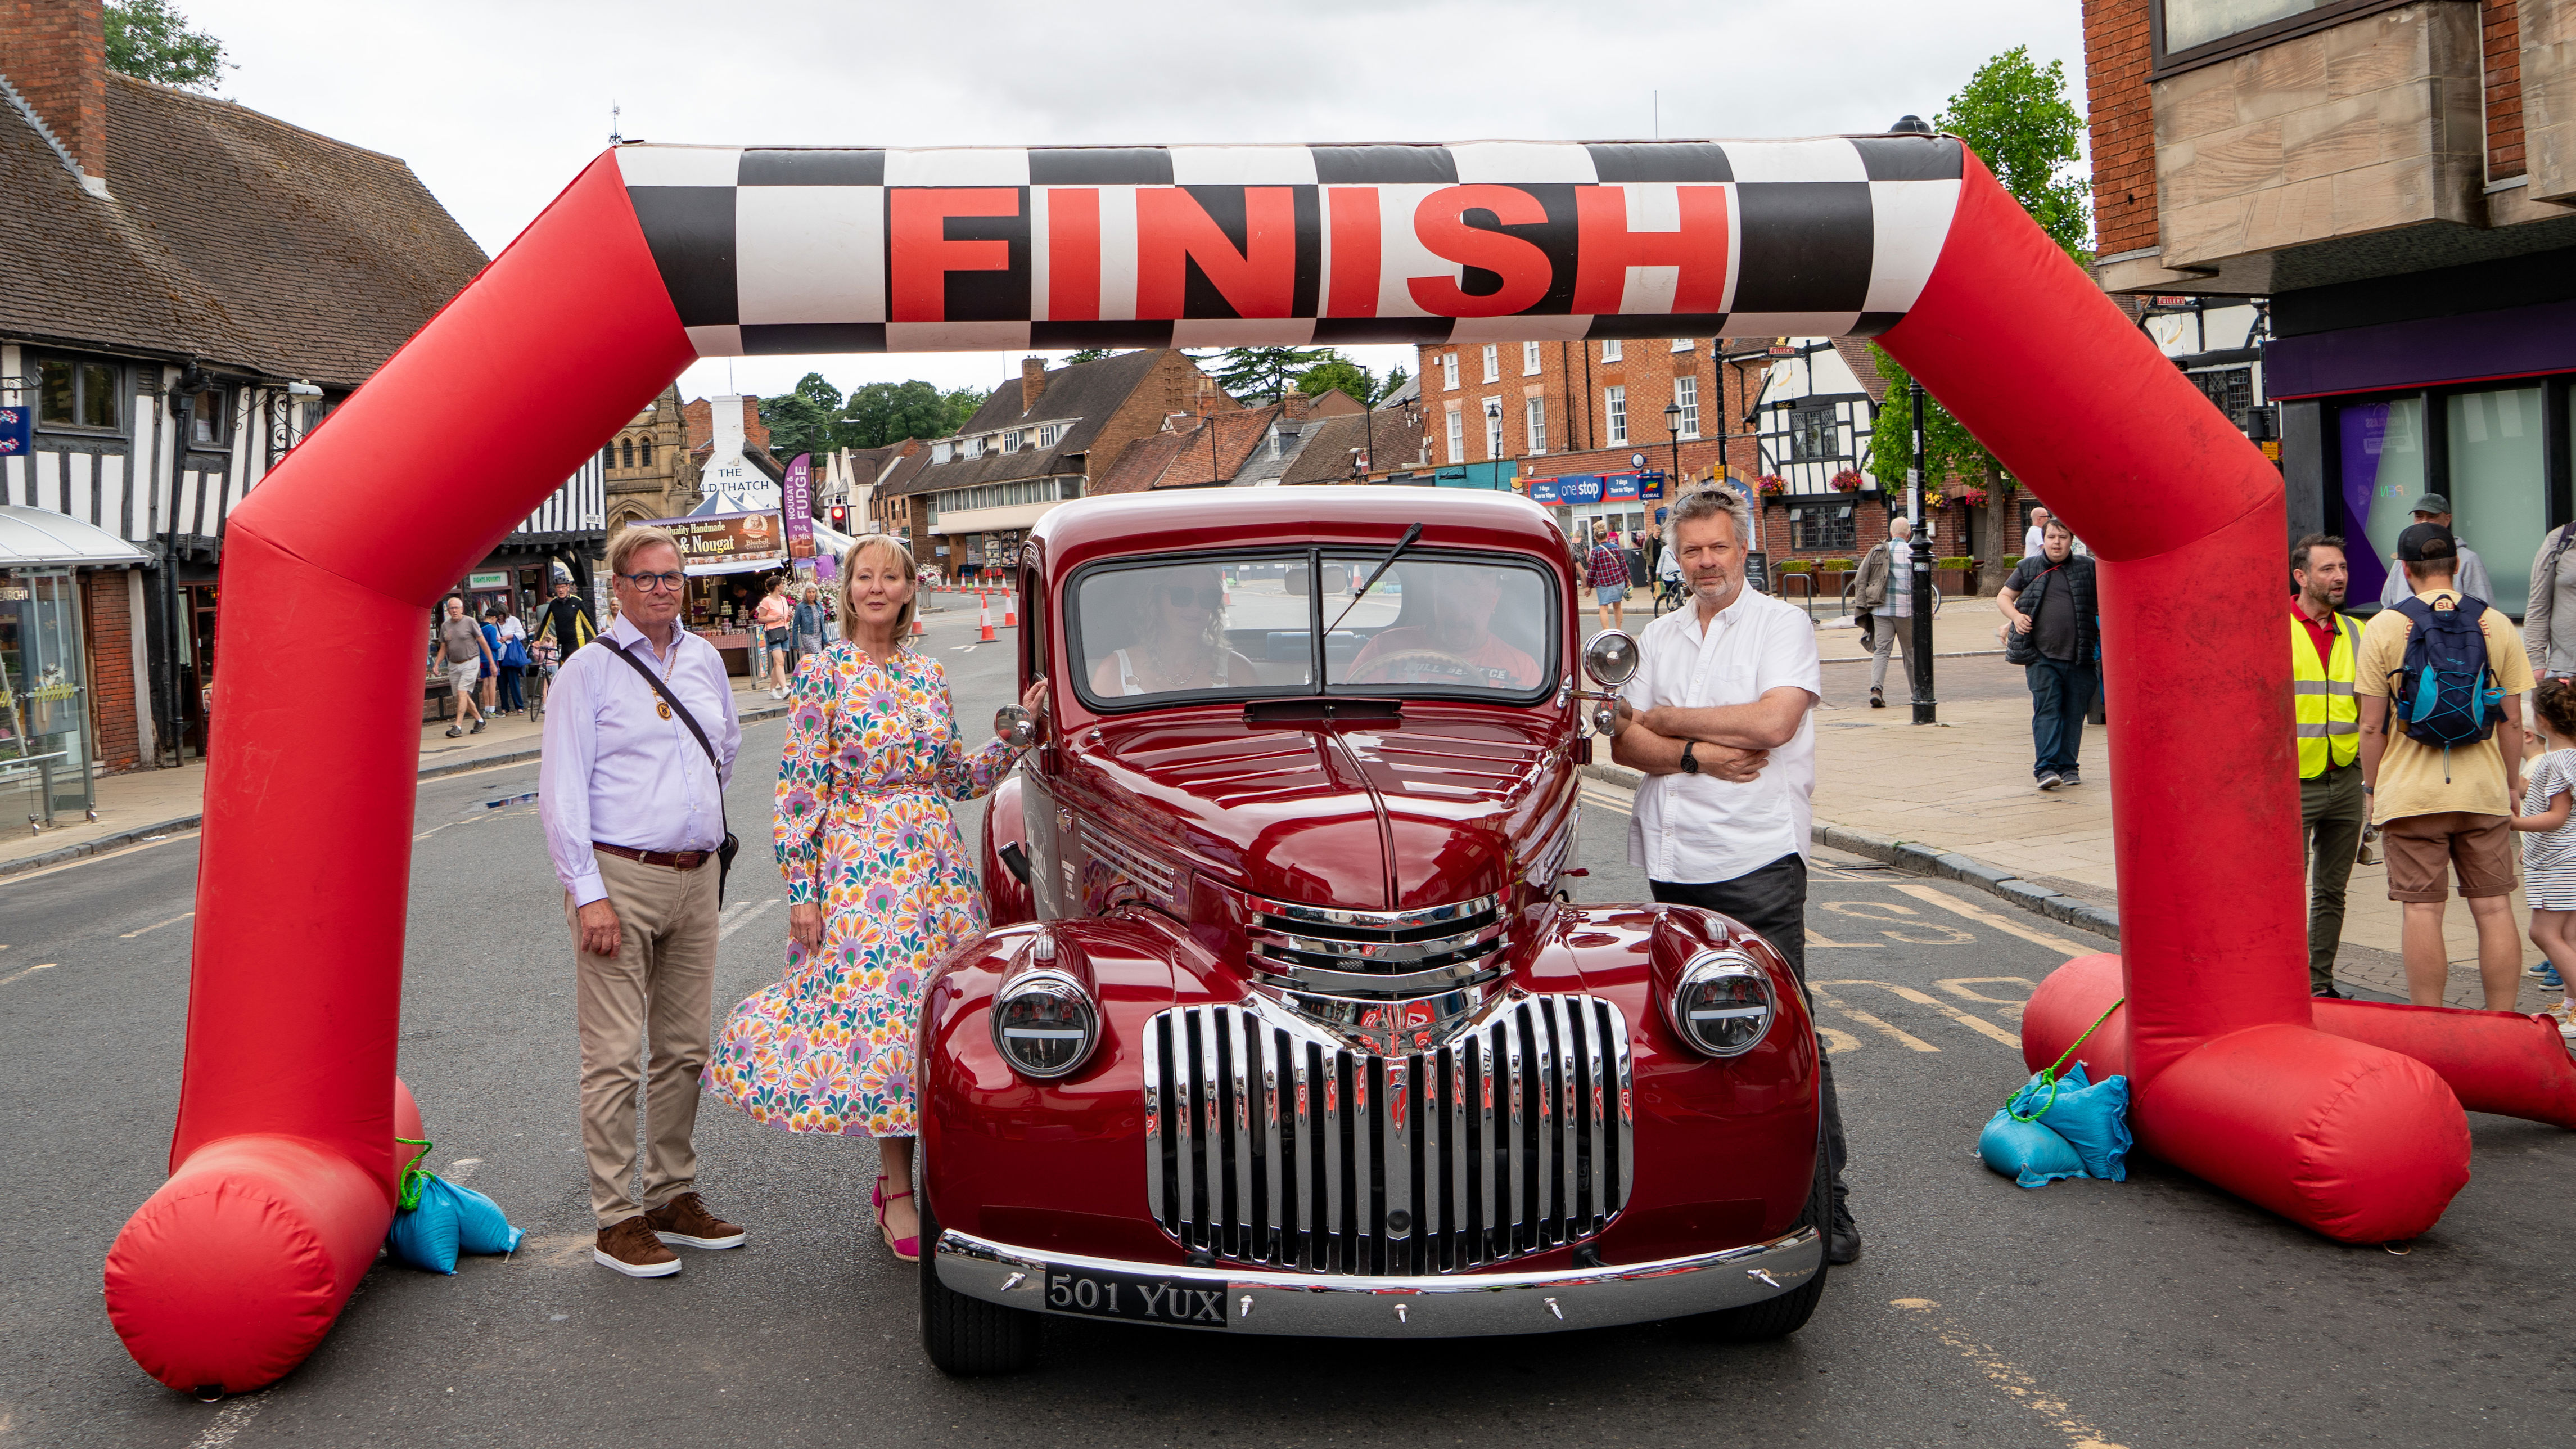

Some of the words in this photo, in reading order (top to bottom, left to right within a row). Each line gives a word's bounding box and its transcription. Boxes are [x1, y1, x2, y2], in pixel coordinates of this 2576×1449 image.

[890, 184, 1730, 323] FINISH
[718, 468, 742, 478] THE
[720, 480, 769, 492] THATCH
[795, 466, 809, 520] FUDGE
[1561, 485, 1577, 497] one
[1578, 480, 1599, 499] stop
[787, 484, 796, 520] NOUGAT
[666, 524, 689, 536] Quality
[690, 521, 726, 534] Handmade
[680, 536, 691, 554] &
[692, 535, 735, 554] Nougat
[746, 538, 769, 546] Bluebell
[1049, 1274, 1120, 1313] 501
[1136, 1280, 1225, 1322] YUX
